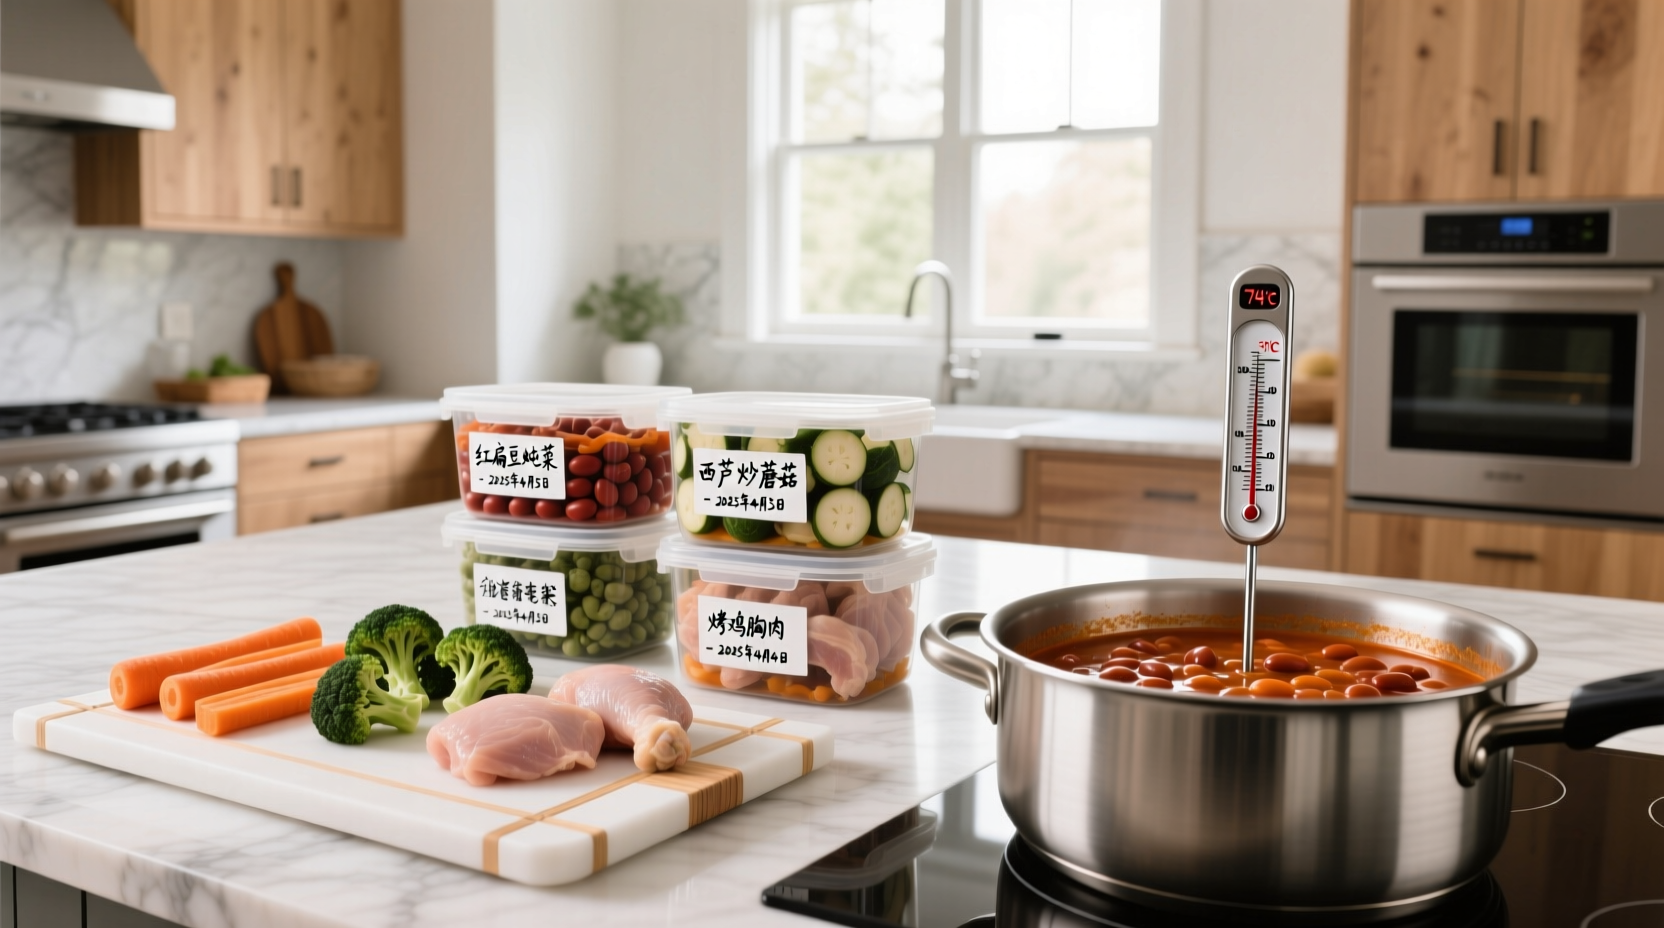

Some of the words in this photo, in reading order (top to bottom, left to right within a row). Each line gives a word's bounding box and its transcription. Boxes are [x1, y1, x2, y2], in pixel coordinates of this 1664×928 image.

[707, 609, 785, 640] 烤鸡胸肉
[717, 644, 788, 664] 2025年4月4日
